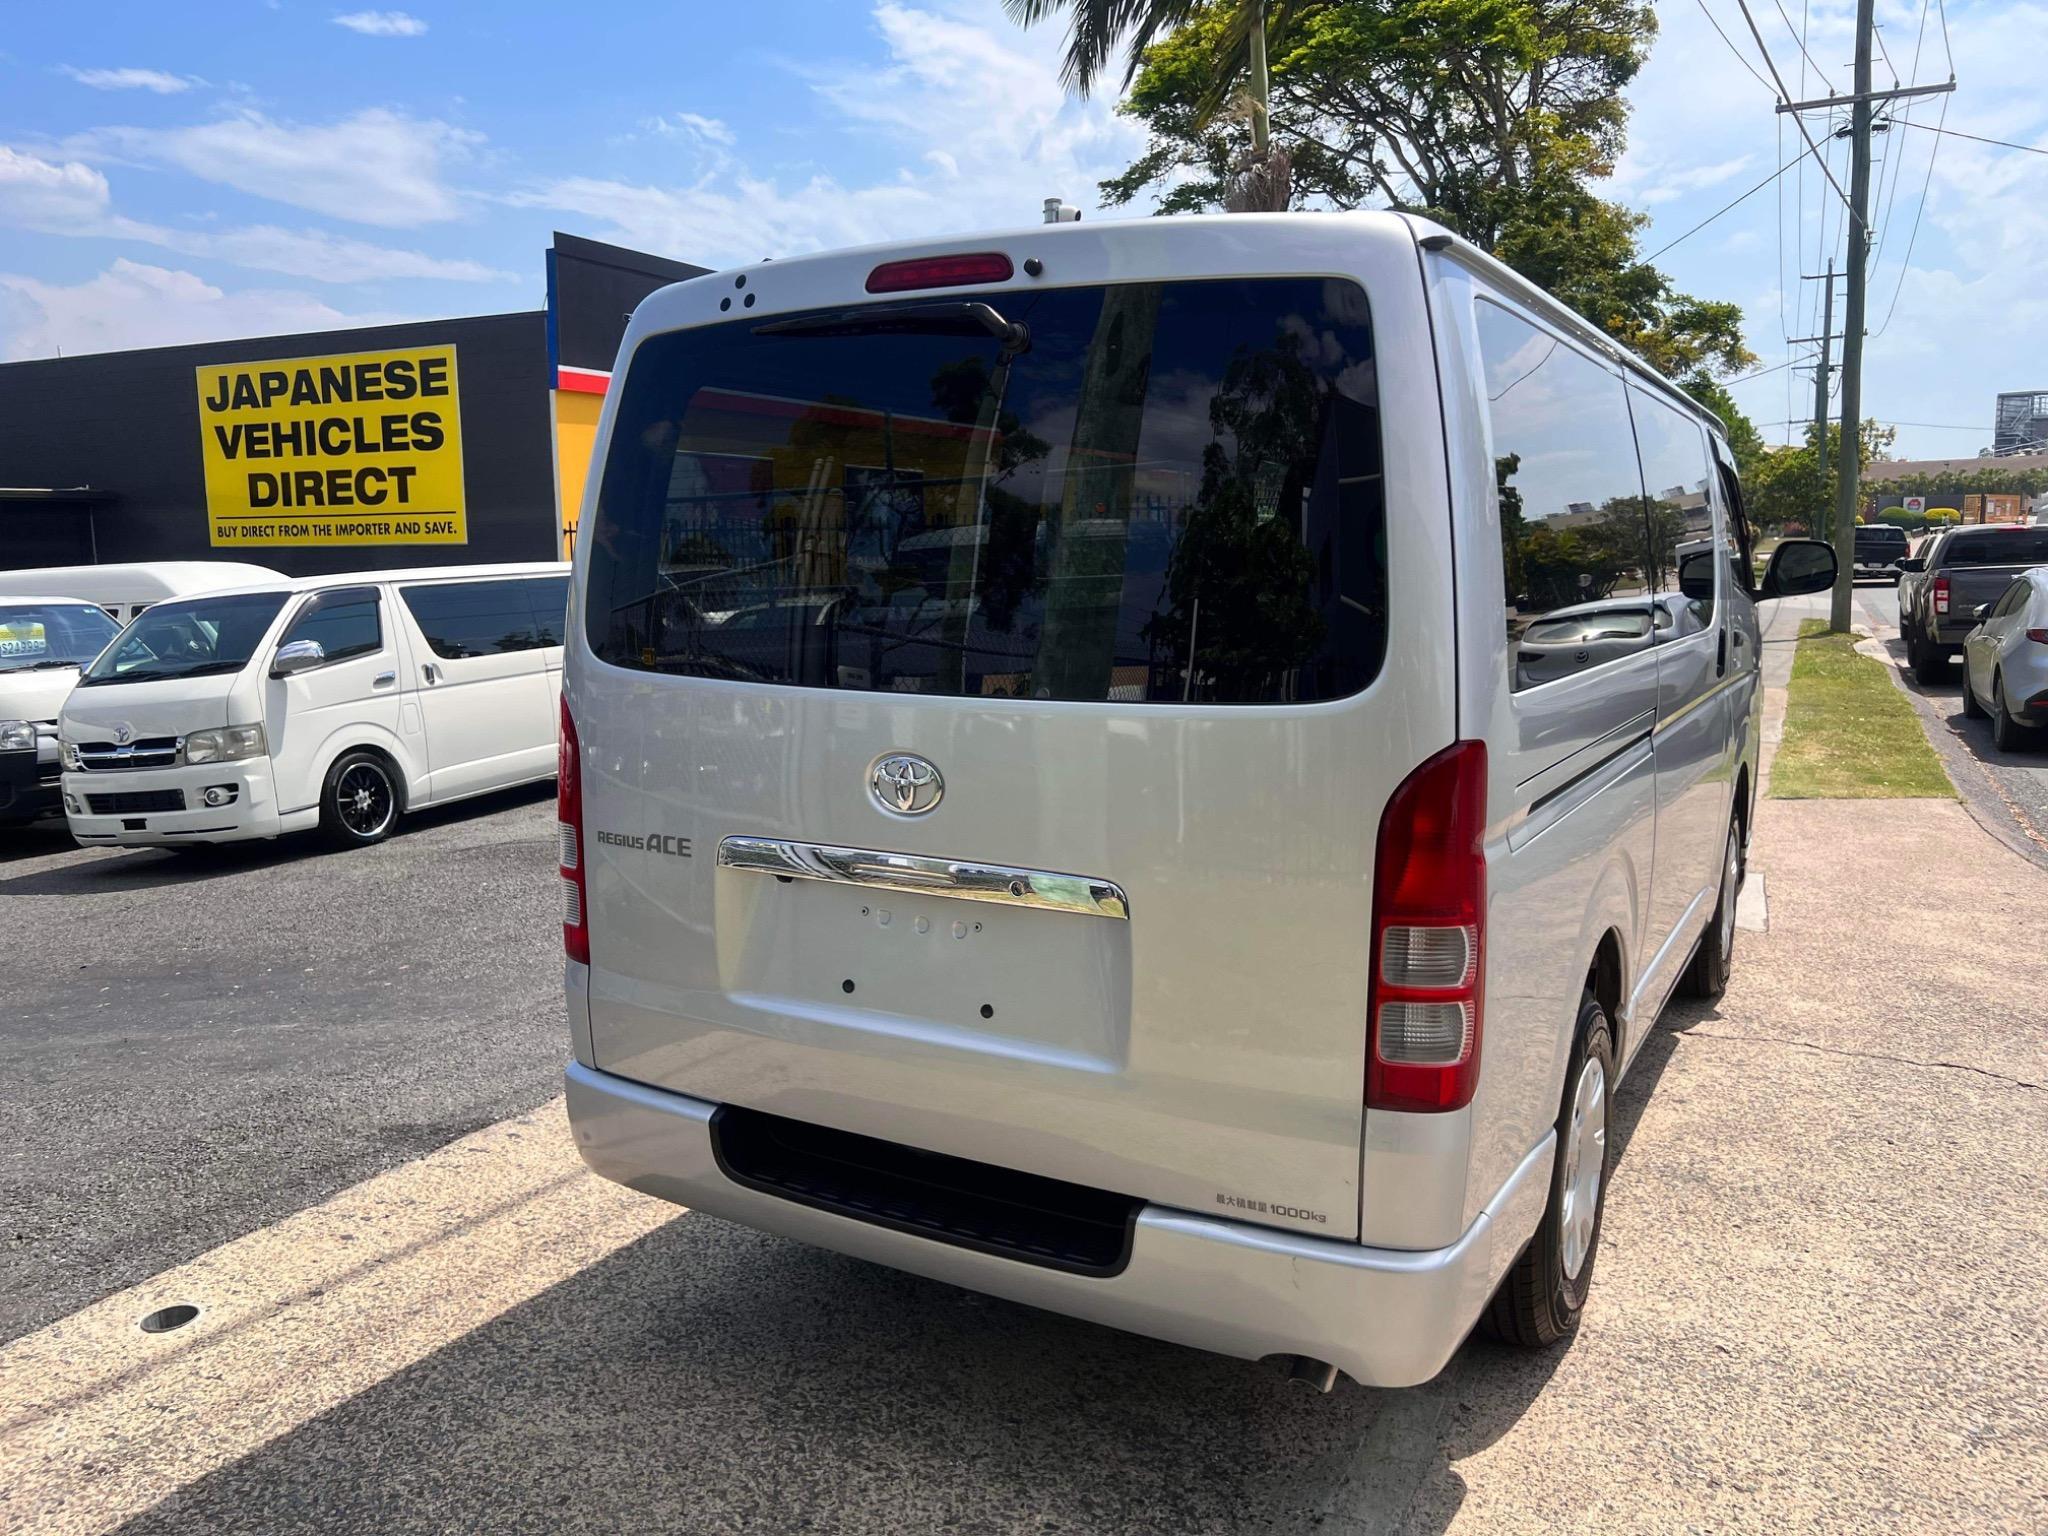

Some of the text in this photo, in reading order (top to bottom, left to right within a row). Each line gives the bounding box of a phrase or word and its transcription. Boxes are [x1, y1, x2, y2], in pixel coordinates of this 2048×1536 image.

[206, 357, 449, 412] JAPANESE
[214, 411, 445, 460] VEHICLES
[247, 466, 416, 508] DIRECT
[217, 521, 457, 538] BUY DIRECT FROM THE IMPORTER AND SAVE.
[1270, 1203, 1327, 1223] 1000kg
